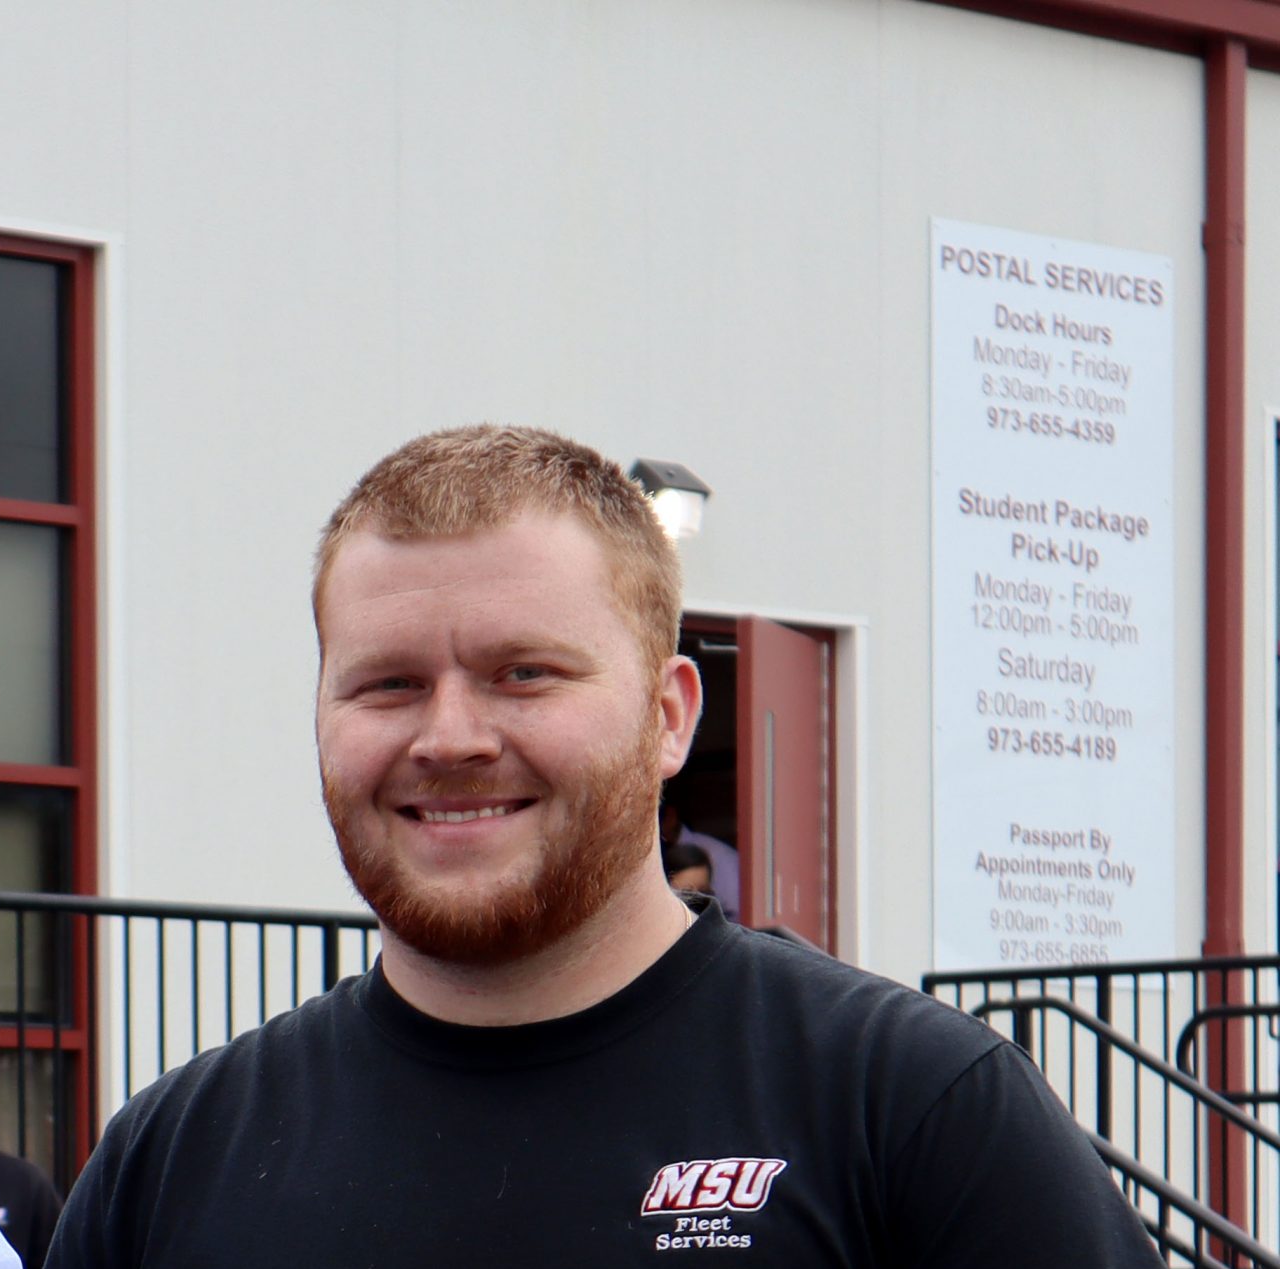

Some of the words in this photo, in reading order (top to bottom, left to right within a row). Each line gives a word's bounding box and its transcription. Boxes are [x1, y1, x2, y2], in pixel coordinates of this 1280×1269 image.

[940, 245, 1036, 286] POSTAL
[1045, 263, 1164, 306] SERVICES
[995, 304, 1046, 335] Dock
[1052, 315, 1112, 345] Hours
[973, 337, 1051, 375] Monday
[1072, 351, 1130, 390] Friday
[981, 374, 1126, 418] 8:30am-5:00pm
[987, 406, 1115, 445] 973-655-4359
[958, 489, 1048, 525] Student
[1055, 501, 1149, 541] Package
[1011, 534, 1099, 572] Pick-Up
[974, 572, 1052, 608] Monday
[1072, 583, 1132, 618] Friday
[971, 605, 1052, 638] 12:00pm
[1071, 616, 1139, 647] 5:00pm
[998, 648, 1096, 692] Saturday
[976, 690, 1046, 720] 8:00am
[1065, 698, 1133, 731] 3:00pm
[988, 727, 1116, 760] 973-655-4189
[1010, 824, 1085, 852] Passport
[1090, 829, 1111, 854] By
[975, 852, 1093, 880] Appointments
[1099, 860, 1135, 885] Only
[998, 880, 1115, 909] Monday-Friday
[990, 909, 1049, 933] 9:00am
[1065, 912, 1123, 940] 3:30pm
[999, 939, 1109, 966] 973-655-6855
[641, 1158, 787, 1216] MSU
[656, 1232, 751, 1250] Services
[675, 1216, 731, 1232] Fleet
